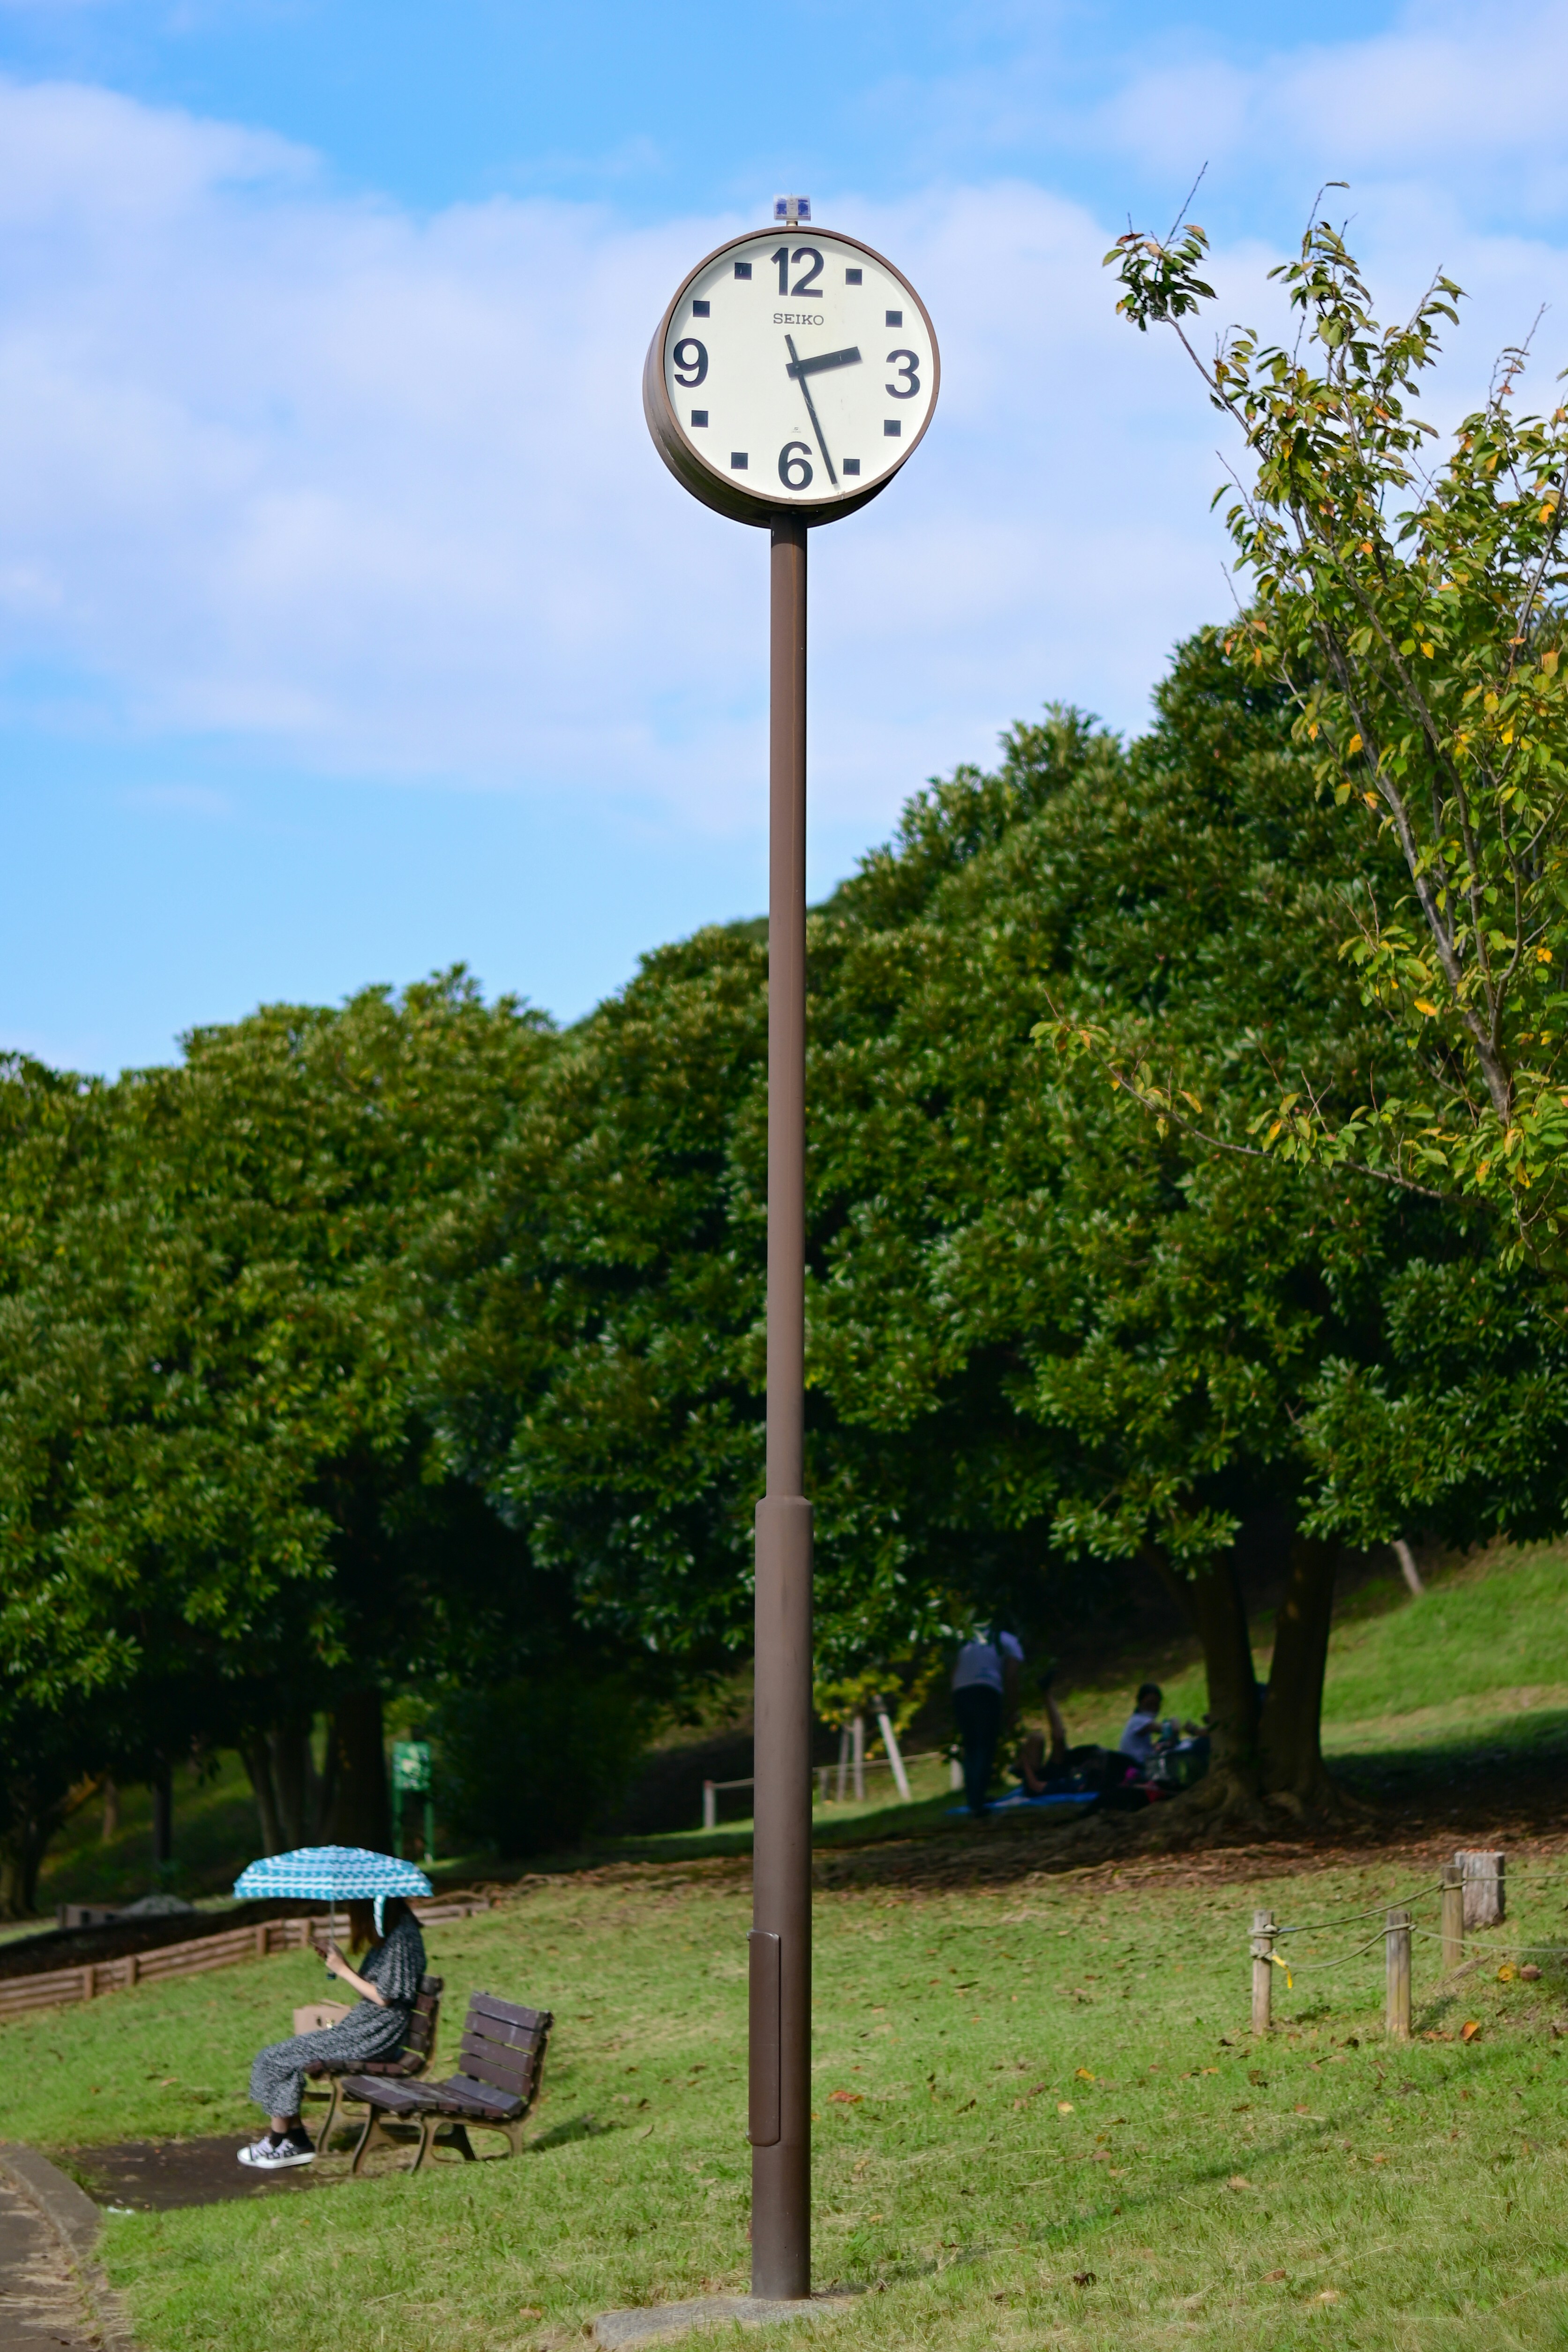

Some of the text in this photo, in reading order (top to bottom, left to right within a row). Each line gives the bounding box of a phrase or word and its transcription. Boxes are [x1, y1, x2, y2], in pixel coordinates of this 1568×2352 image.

[770, 247, 824, 298] 12
[773, 313, 824, 325] SEIKO
[674, 338, 708, 388] 9
[885, 350, 920, 399] 3
[778, 442, 813, 490] 6
